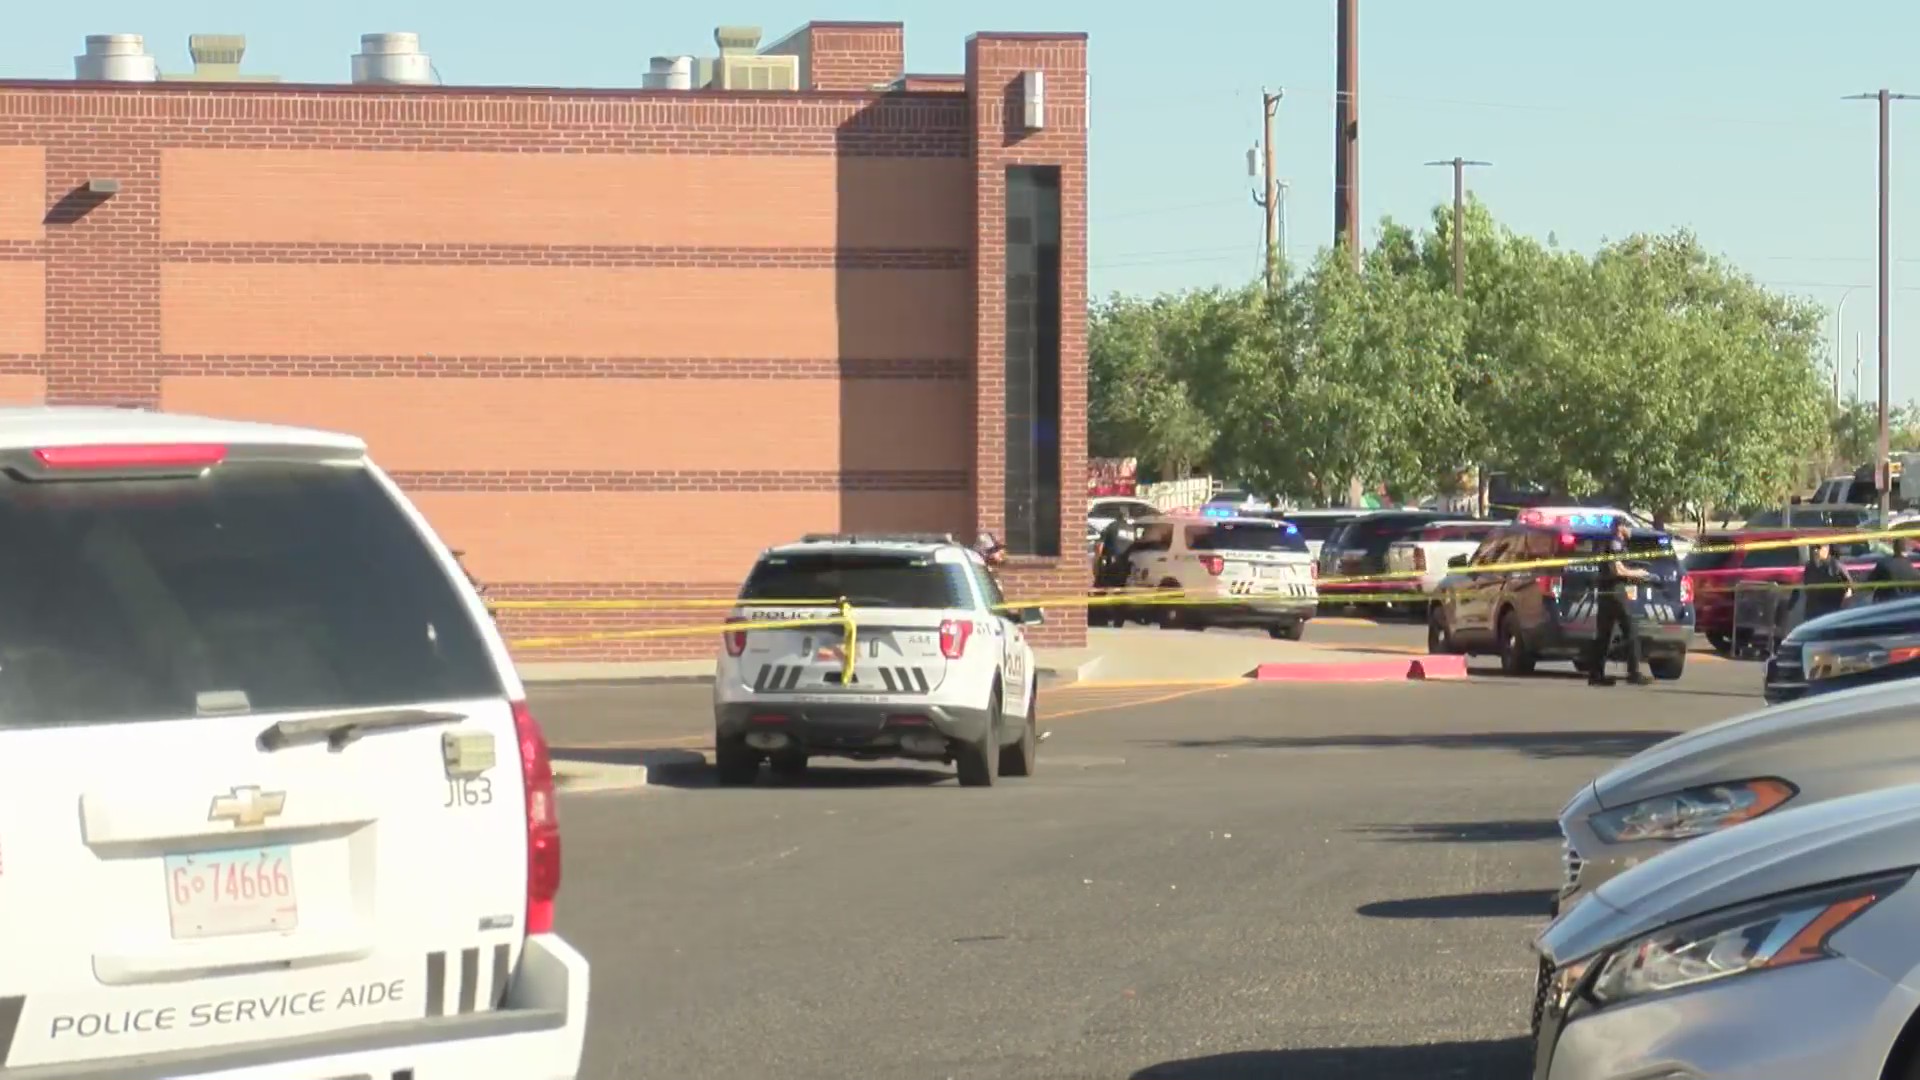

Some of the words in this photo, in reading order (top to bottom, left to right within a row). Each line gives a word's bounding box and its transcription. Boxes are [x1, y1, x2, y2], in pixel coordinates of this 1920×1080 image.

[444, 777, 492, 807] J163
[50, 1007, 177, 1039] POLICE
[188, 990, 327, 1027] SERVICE
[335, 979, 406, 1010] AIDE
